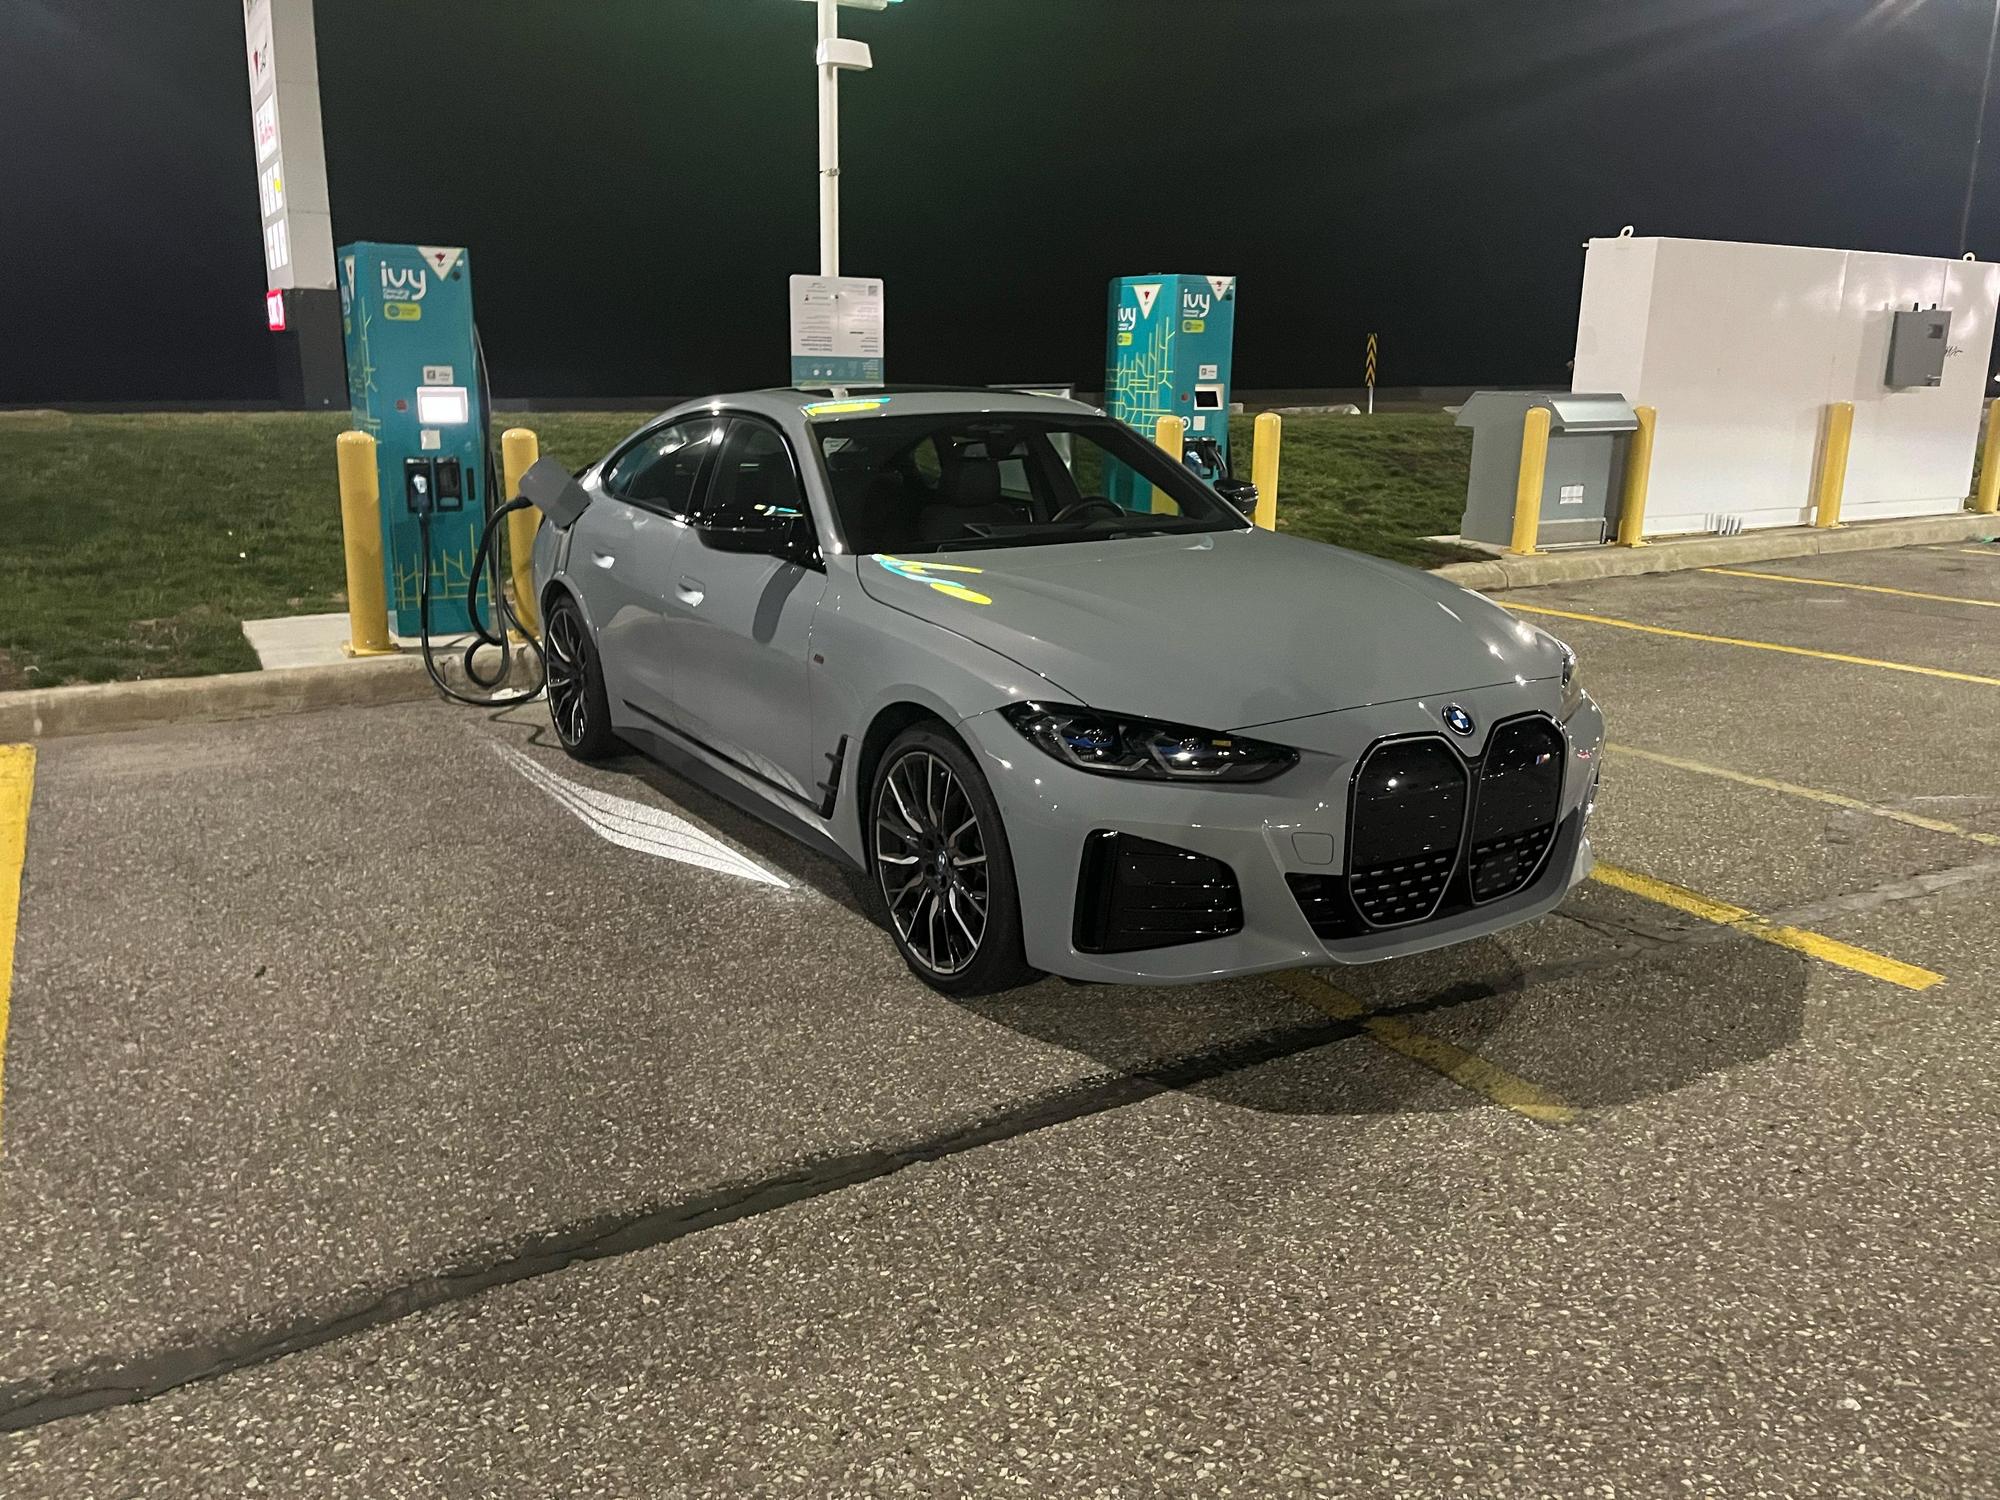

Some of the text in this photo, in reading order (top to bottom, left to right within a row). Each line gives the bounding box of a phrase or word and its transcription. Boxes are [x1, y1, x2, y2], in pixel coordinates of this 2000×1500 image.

[380, 260, 427, 301] ivy
[1117, 304, 1137, 331] ivy
[1183, 288, 1211, 318] ivy
